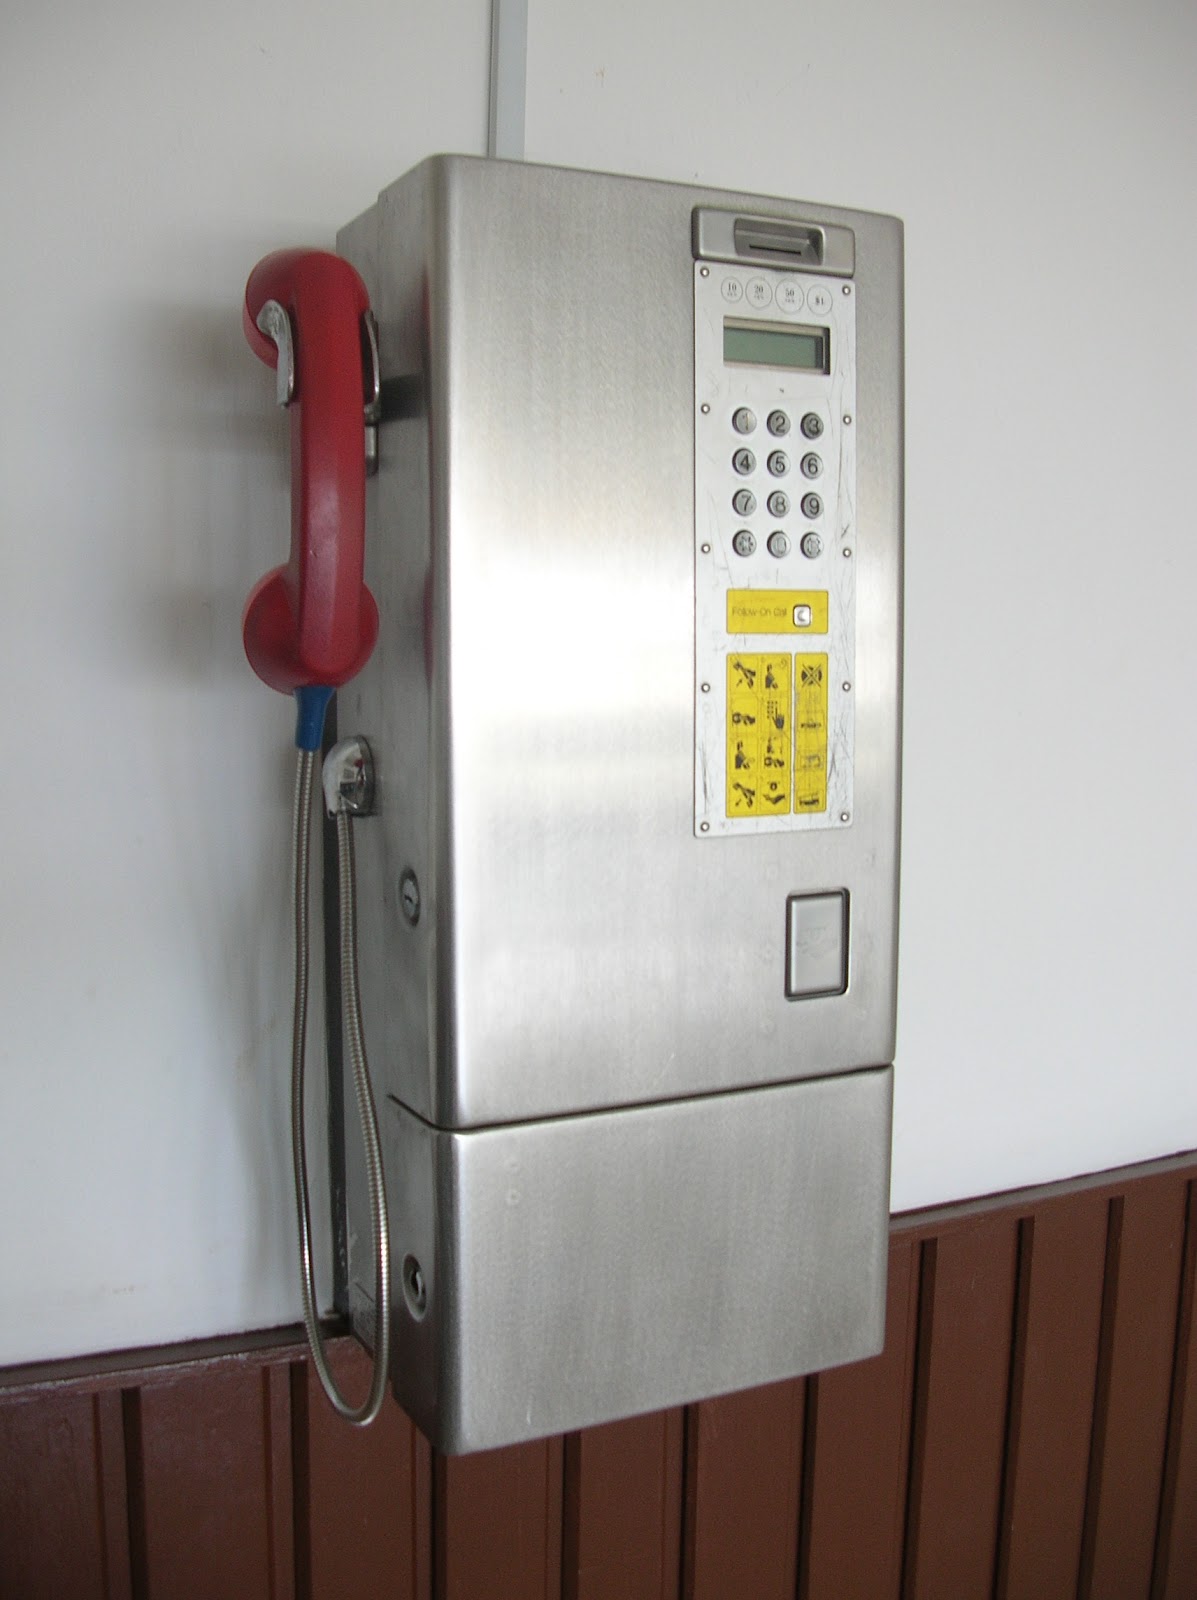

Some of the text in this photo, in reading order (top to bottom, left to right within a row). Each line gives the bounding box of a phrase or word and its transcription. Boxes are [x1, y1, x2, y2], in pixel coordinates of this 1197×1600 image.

[728, 283, 737, 292] 10
[755, 285, 763, 294] 20
[785, 288, 794, 297] 50
[742, 413, 750, 431] 1
[775, 415, 785, 433] 2
[808, 418, 819, 435] 3
[740, 453, 750, 472] 4
[775, 456, 785, 474] 5
[808, 457, 818, 475] 6
[742, 494, 751, 512] 7
[775, 496, 786, 514] 8
[809, 498, 820, 515] 9
